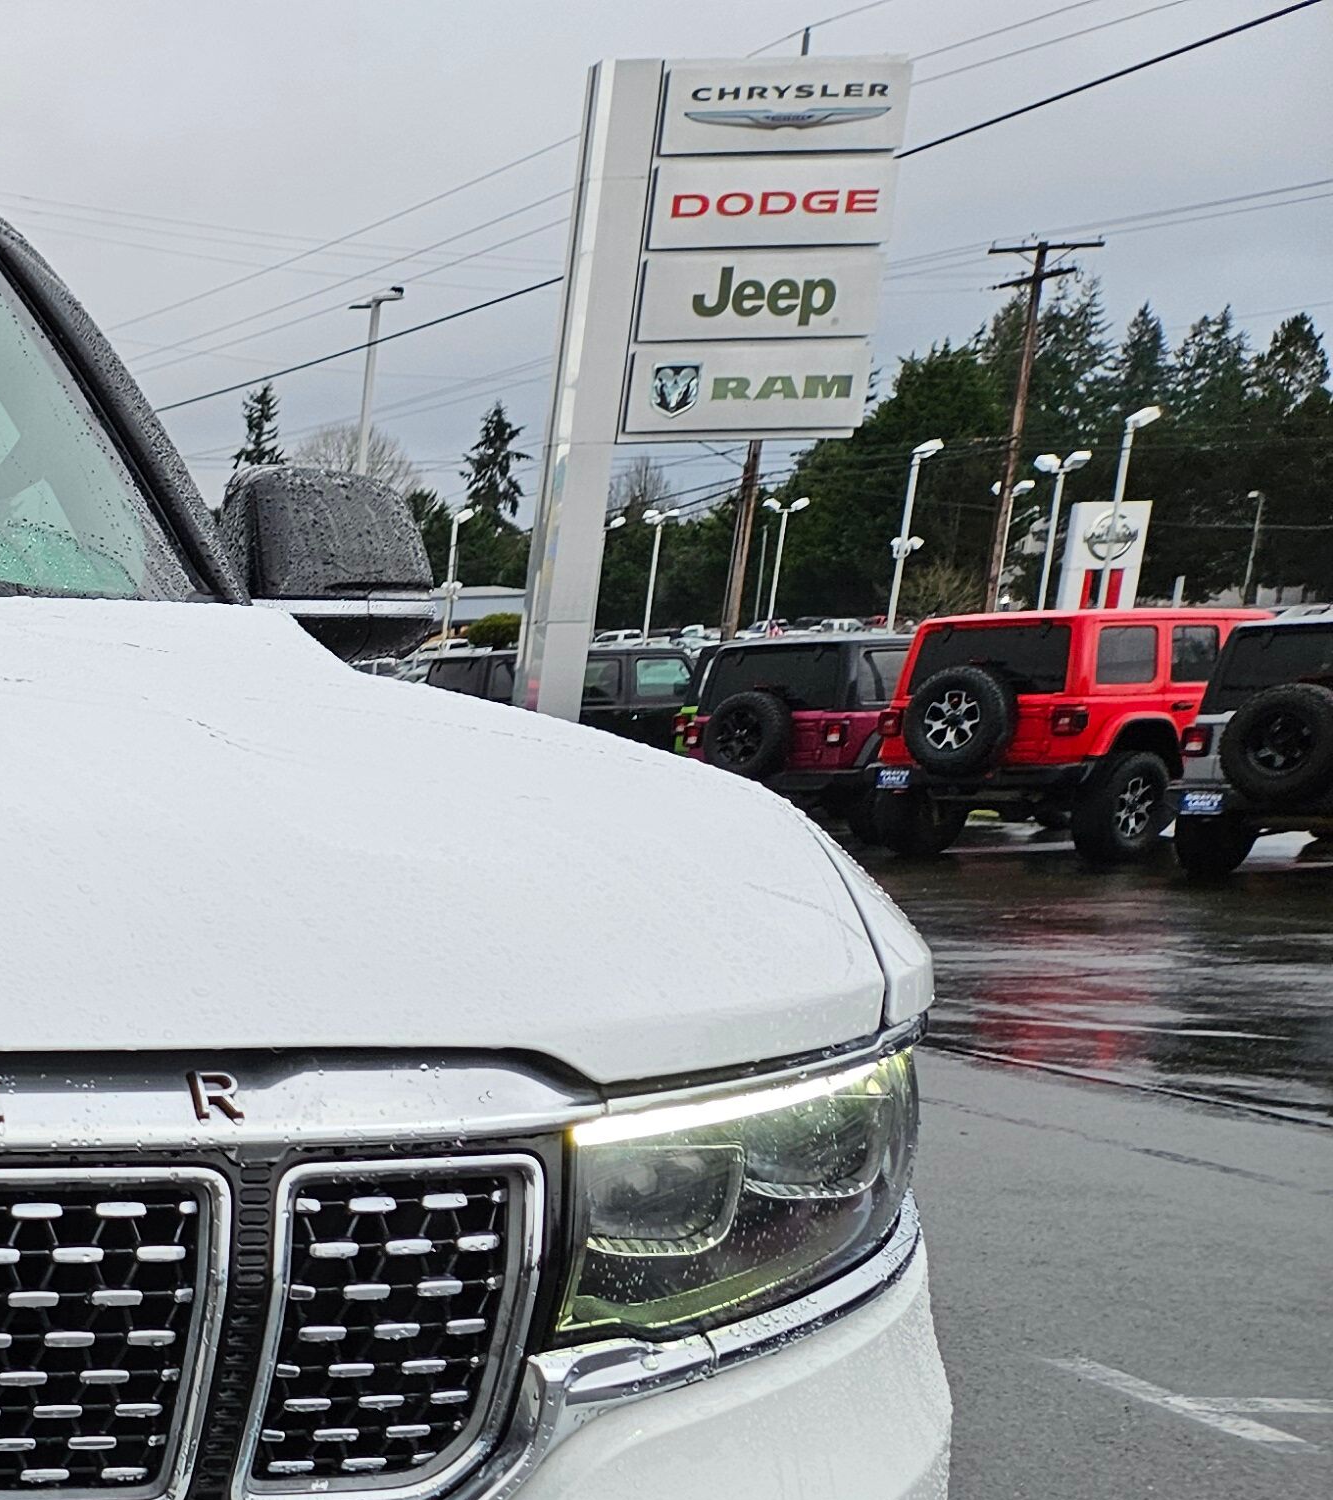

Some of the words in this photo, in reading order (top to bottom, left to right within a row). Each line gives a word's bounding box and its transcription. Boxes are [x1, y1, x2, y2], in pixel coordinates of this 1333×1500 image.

[691, 83, 889, 101] CHRYSLER
[670, 188, 880, 219] DODGE
[692, 265, 837, 327] Jeep
[710, 374, 854, 401] RAM
